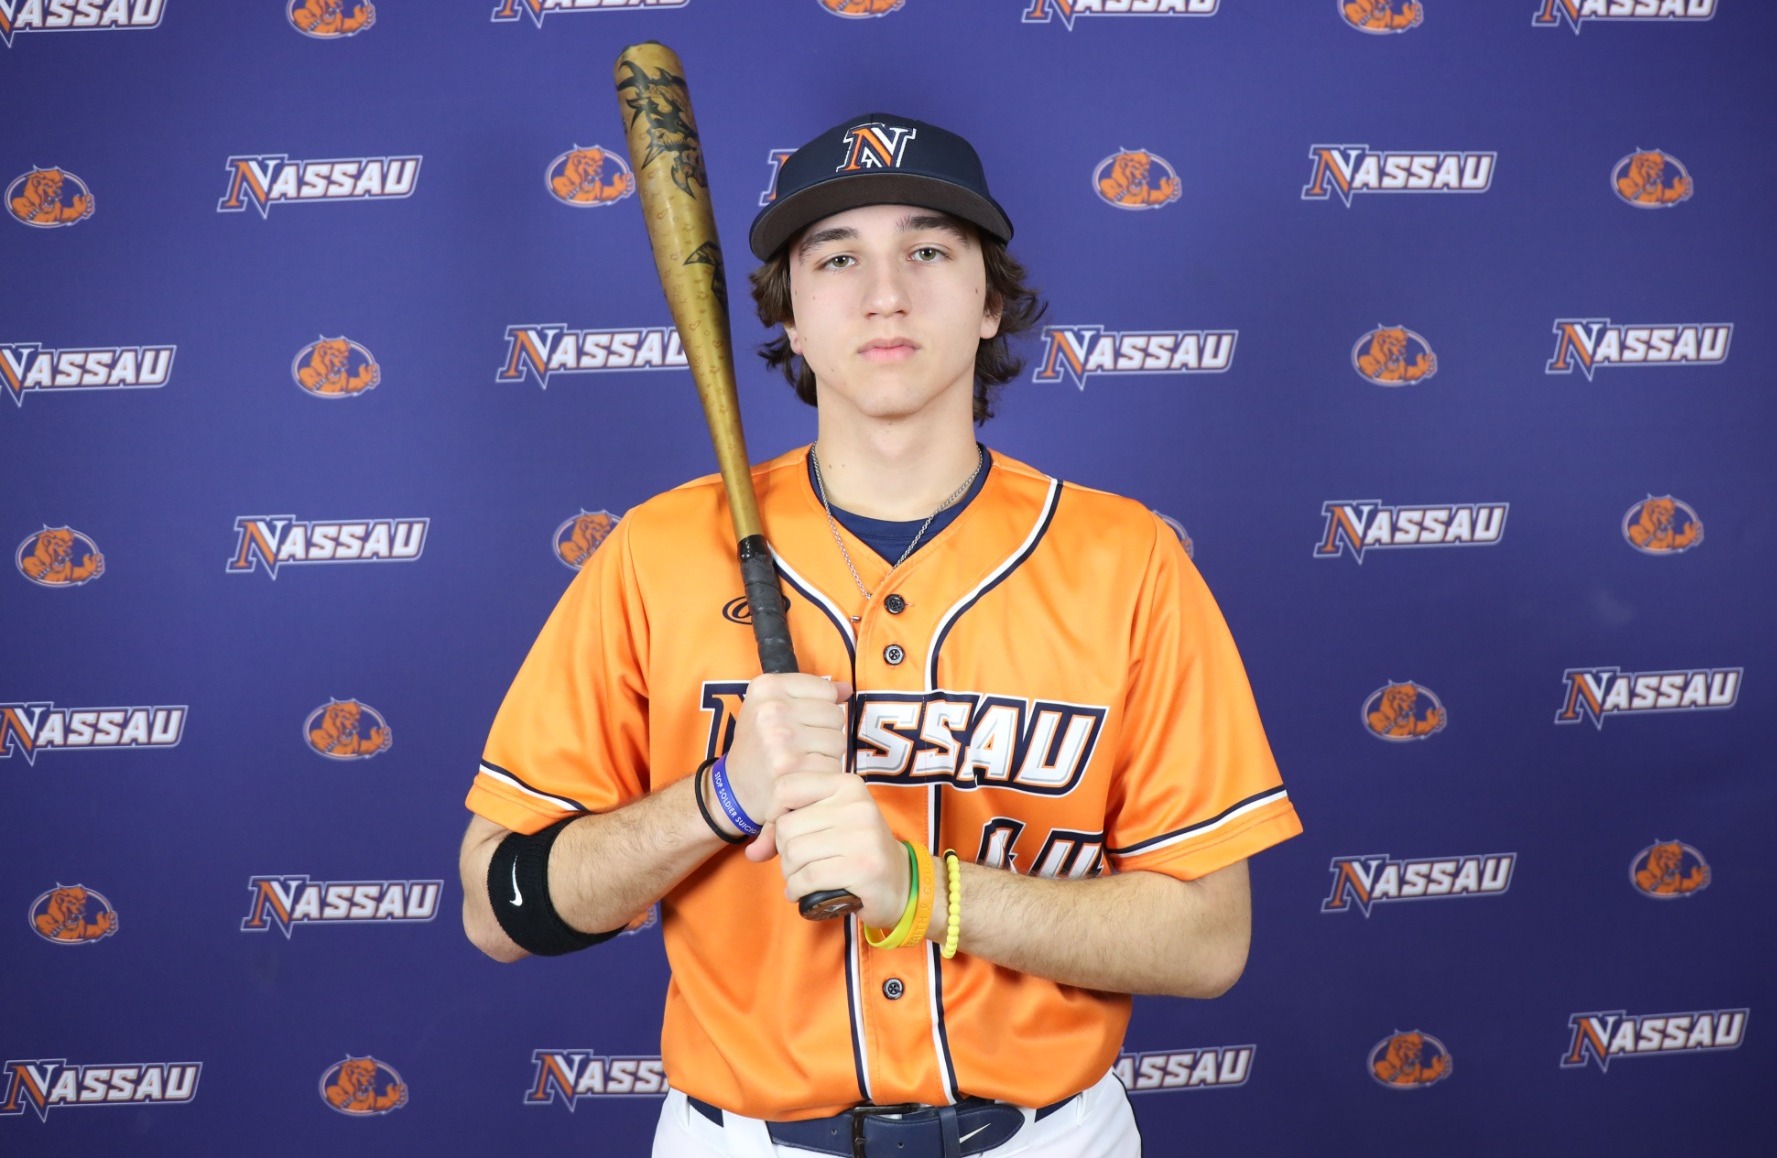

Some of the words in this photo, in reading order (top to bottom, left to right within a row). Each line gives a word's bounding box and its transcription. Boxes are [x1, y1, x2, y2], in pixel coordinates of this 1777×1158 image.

[218, 156, 420, 214] NASSAU
[1303, 147, 1494, 203] NASSAU
[1035, 327, 1235, 387] NASSAU
[1548, 321, 1731, 377] NASSAU
[228, 517, 427, 576] NASSAU
[1316, 503, 1506, 560] NASSAU
[1558, 669, 1740, 725] NASSAU
[0, 704, 185, 761] NASSAU
[700, 677, 1110, 797] SSAU
[714, 771, 724, 788] STOP
[719, 788, 738, 818] SOLDIER
[735, 816, 760, 836] SUICID
[243, 877, 440, 934] NASSAU
[1323, 855, 1513, 913] NASSAU
[1563, 1010, 1746, 1067] NASSAU
[1, 1060, 199, 1117] NASSAU
[526, 1050, 668, 1108] NASS
[1113, 1046, 1253, 1091] ASSAU
